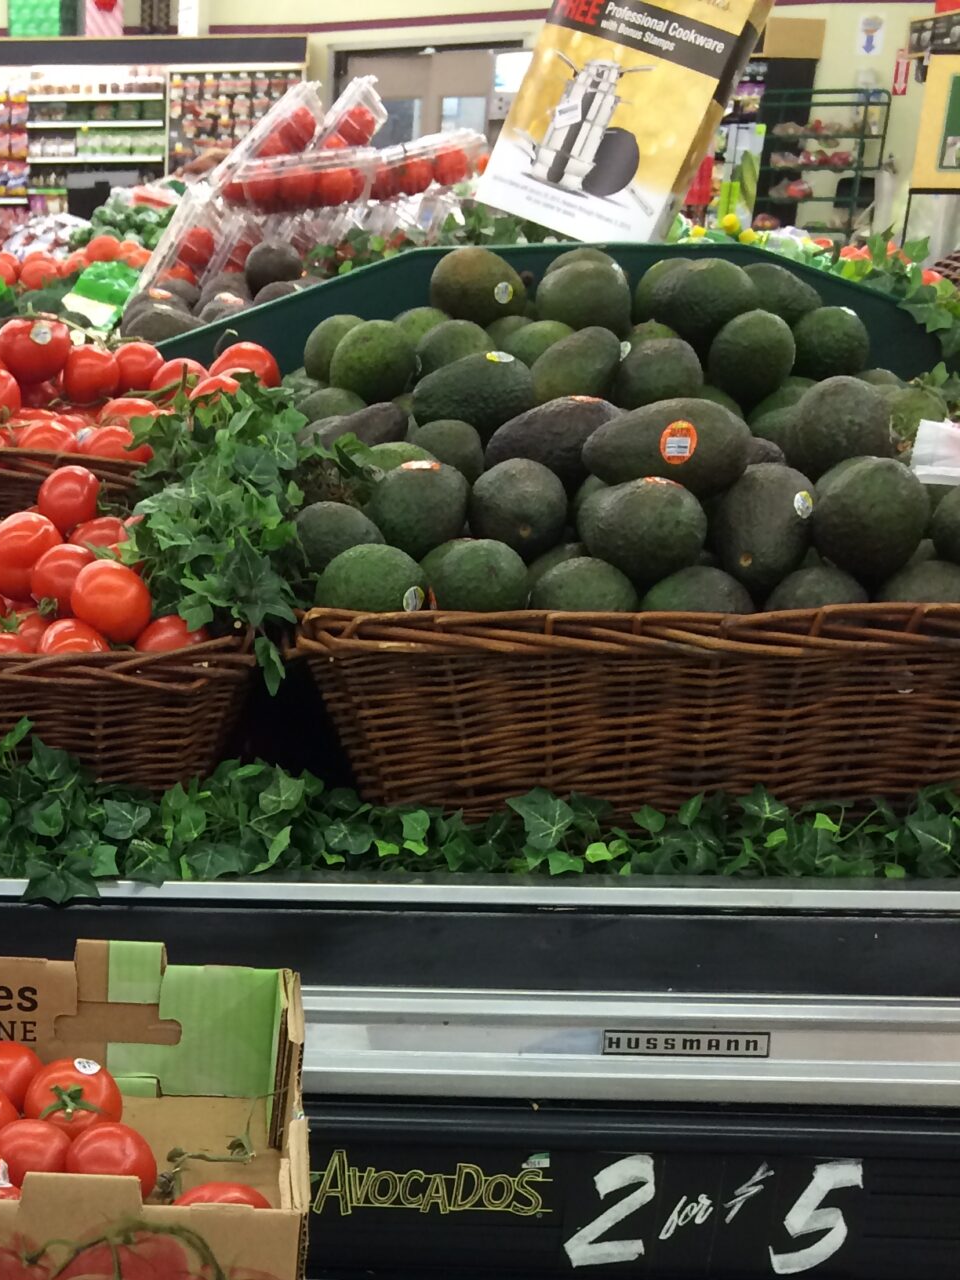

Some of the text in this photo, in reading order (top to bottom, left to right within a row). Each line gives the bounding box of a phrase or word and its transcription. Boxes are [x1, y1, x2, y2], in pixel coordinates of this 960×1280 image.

[553, 0, 726, 54] FREE Professional Cookware
[643, 31, 676, 52] Stamps
[607, 1034, 761, 1053] HUSSMANN
[563, 1153, 656, 1269] 2
[659, 1193, 713, 1240] for
